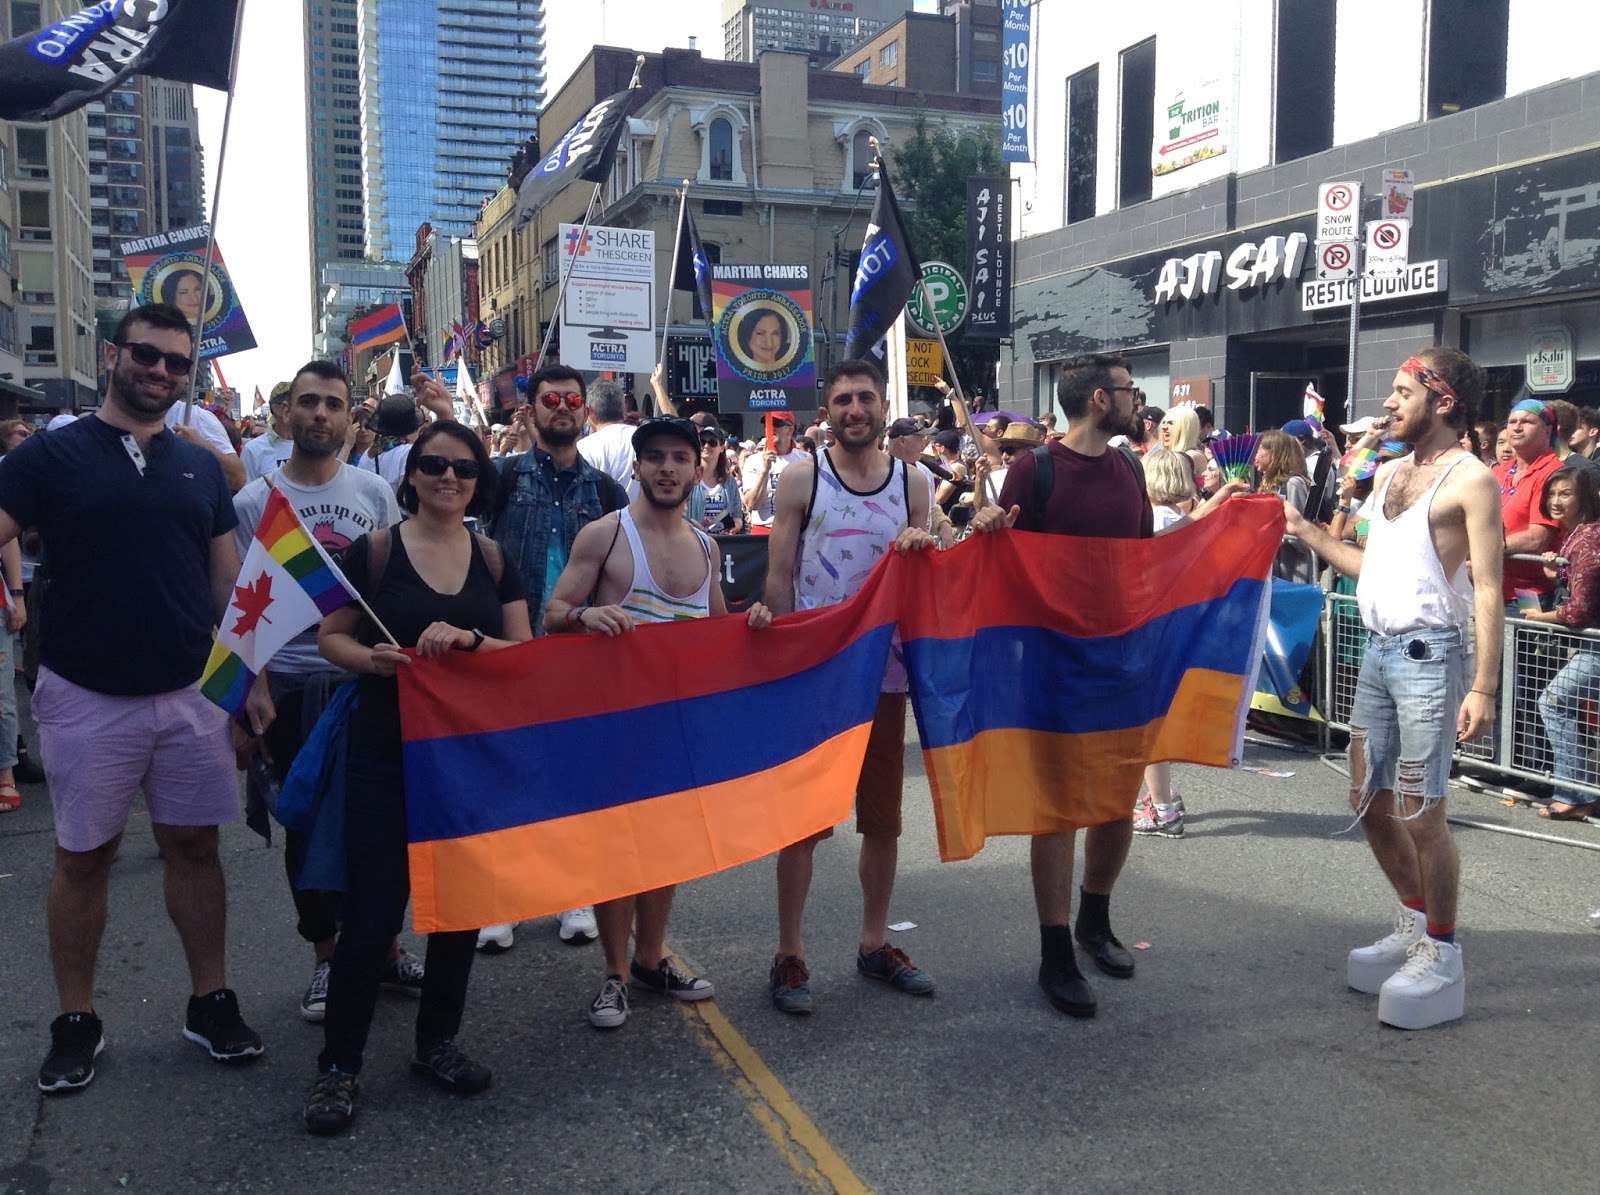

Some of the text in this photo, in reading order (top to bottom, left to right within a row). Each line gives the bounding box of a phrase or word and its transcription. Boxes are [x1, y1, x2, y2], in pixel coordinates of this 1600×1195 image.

[1010, 10, 1024, 20] Per
[1005, 20, 1030, 32] Month
[68, 0, 169, 83] CTRA
[1003, 42, 1028, 69] $10
[1008, 72, 1022, 82] Per
[1003, 82, 1028, 93] Month
[1003, 103, 1027, 130] $10
[1168, 100, 1220, 129] TRITION
[1202, 114, 1219, 128] BAR
[1007, 133, 1021, 142] Per
[1003, 142, 1028, 153] Month
[1324, 215, 1352, 225] SNOW
[1322, 226, 1353, 237] ROUTE
[120, 224, 210, 256] MARTHA CHAVES
[596, 230, 651, 250] SHARE
[596, 249, 652, 262] THESCREEN
[713, 265, 762, 279] MARTHA
[763, 265, 808, 279] CHAVES
[1155, 232, 1308, 305] AJI SAI
[921, 266, 961, 290] ICIPAL
[995, 249, 1003, 307] LOUNGE
[733, 291, 767, 309] TORONTO
[771, 294, 807, 333] AMBASSADOR
[971, 312, 996, 322] PLUS
[198, 336, 226, 351] CTRA
[199, 344, 228, 357] ORONTO
[592, 343, 625, 354] ACTRA
[913, 342, 933, 354] NOT
[593, 352, 625, 360] TORONTO
[678, 345, 717, 362] HOUS
[1533, 349, 1564, 364] Asahi
[742, 366, 791, 380] PRIDE 2017
[682, 377, 718, 394] LORD
[1172, 383, 1190, 398] AJI
[749, 389, 787, 400] ACTRA
